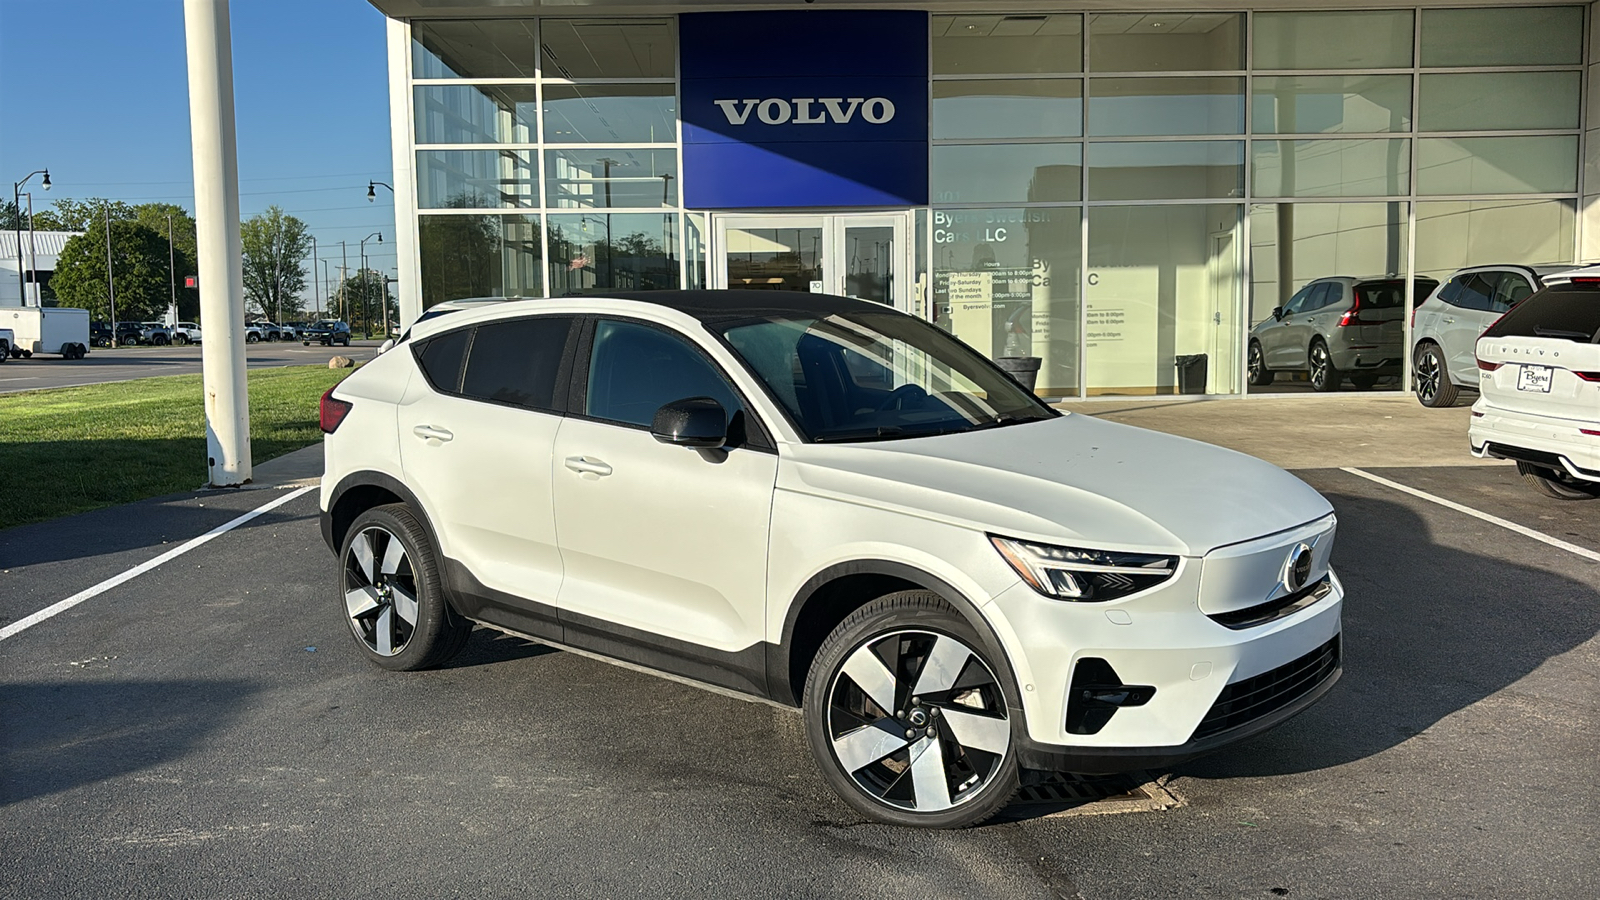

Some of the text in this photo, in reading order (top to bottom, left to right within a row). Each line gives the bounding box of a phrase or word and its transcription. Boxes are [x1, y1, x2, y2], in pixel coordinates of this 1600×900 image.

[714, 97, 896, 125] VOLVO
[935, 211, 979, 228] Byers
[934, 227, 1008, 244] Cars LLC
[1502, 347, 1560, 358] VOLVO
